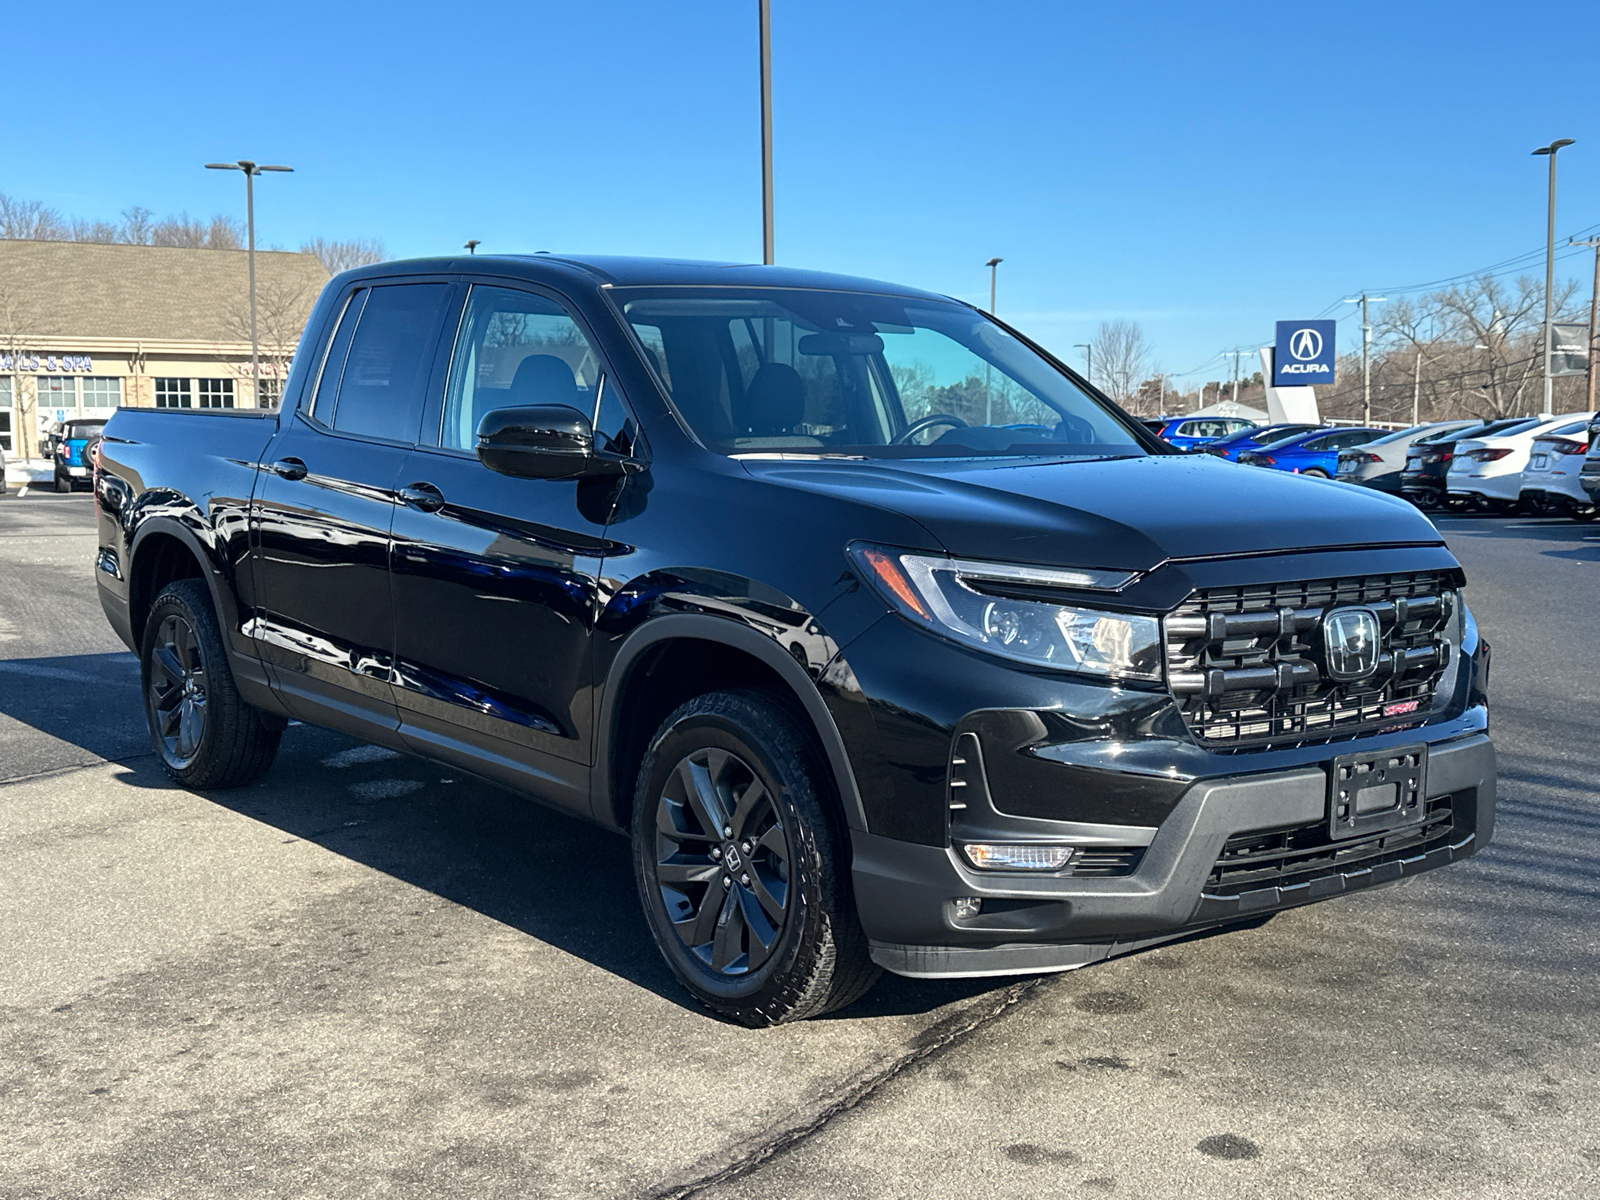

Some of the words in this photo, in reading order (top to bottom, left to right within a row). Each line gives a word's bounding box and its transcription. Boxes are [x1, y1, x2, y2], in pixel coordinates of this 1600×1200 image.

[0, 355, 40, 370] ALS
[47, 355, 57, 371] &
[62, 355, 92, 371] SPA
[1280, 363, 1330, 374] ACURA
[1384, 700, 1419, 716] SPORT
